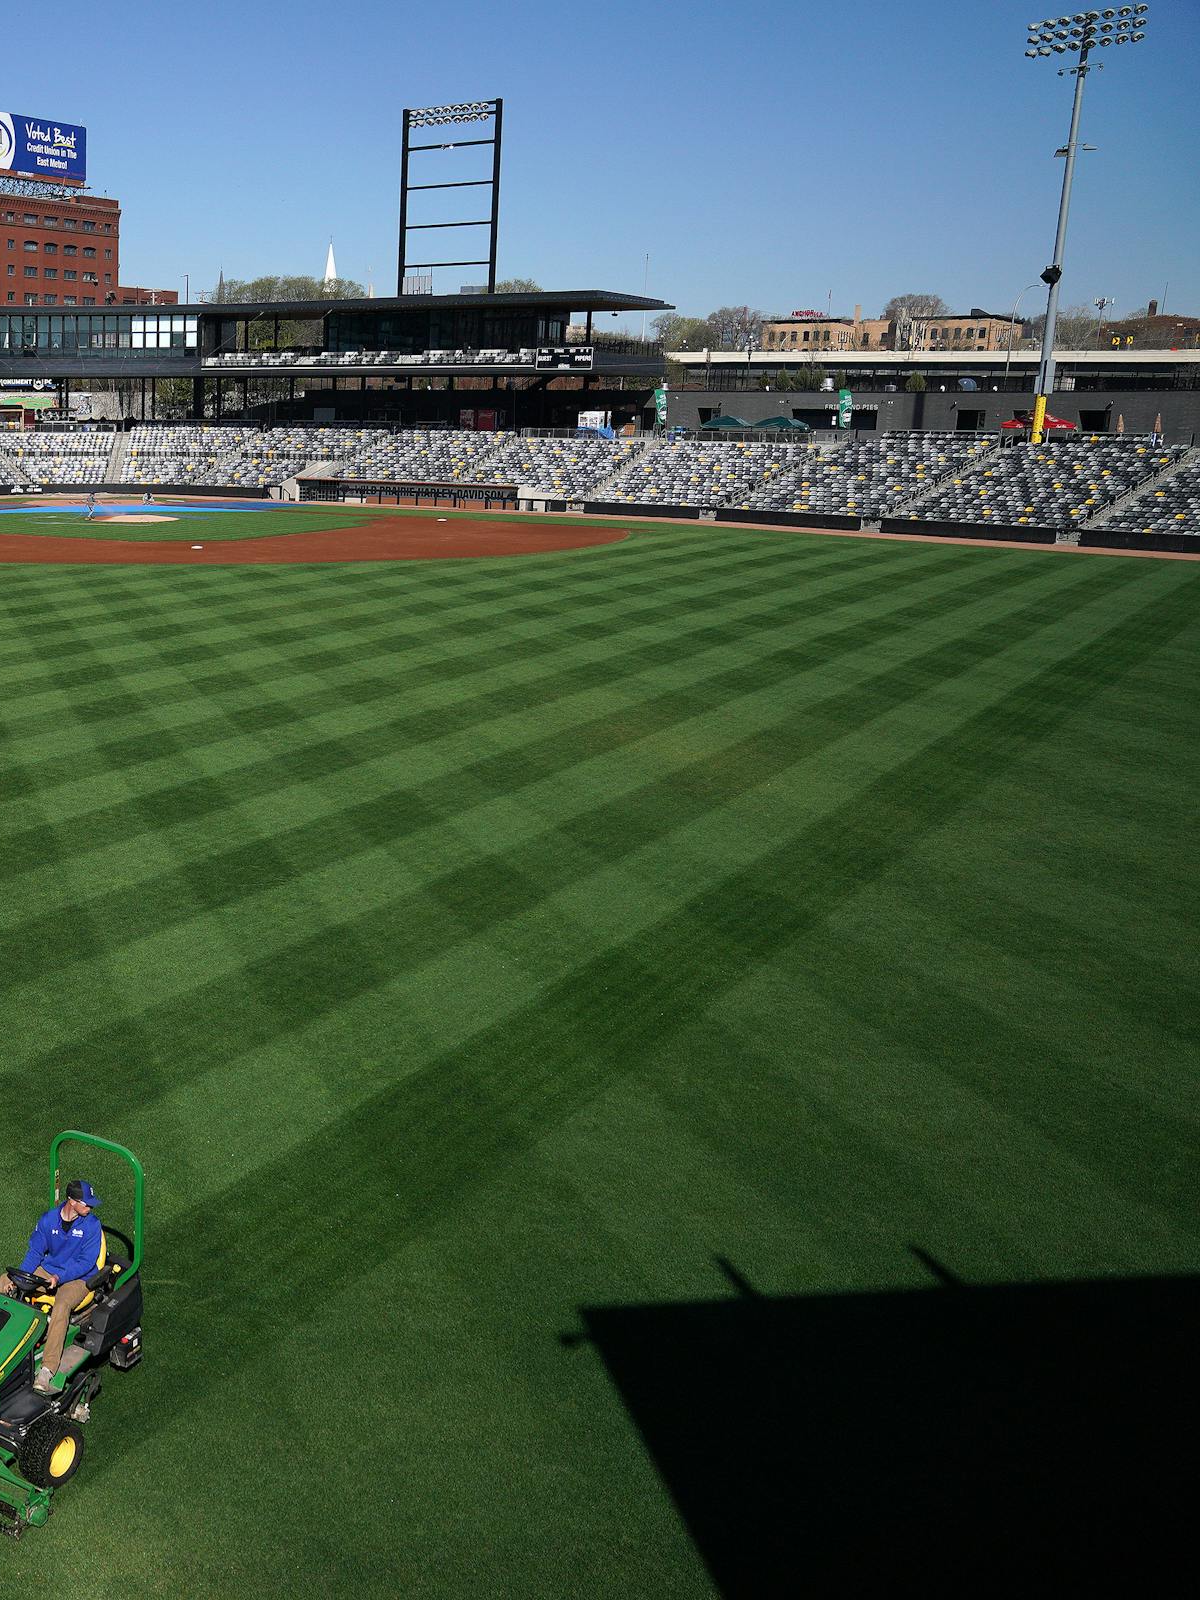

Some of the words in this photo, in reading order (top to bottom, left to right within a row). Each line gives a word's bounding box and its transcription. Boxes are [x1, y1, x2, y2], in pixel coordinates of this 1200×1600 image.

[25, 121, 51, 142] Voted
[53, 127, 76, 146] Best
[26, 142, 43, 154] Credit
[44, 145, 60, 156] Union
[36, 156, 49, 167] East
[50, 158, 67, 169] Metro!
[862, 403, 879, 411] PIES
[380, 486, 415, 496] PRAIRIE
